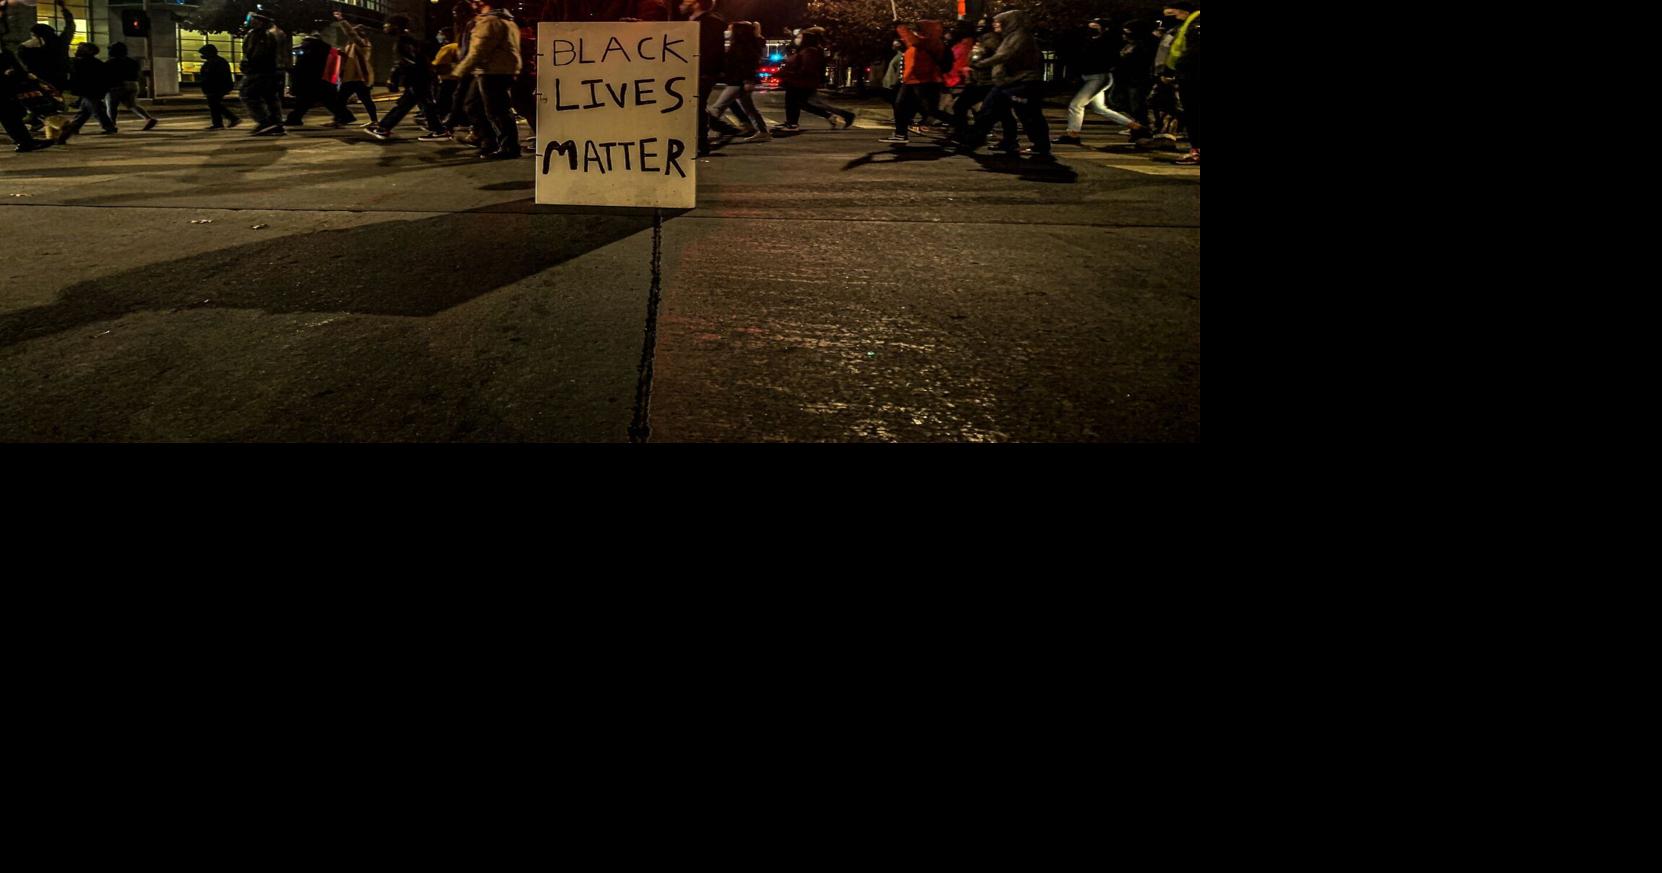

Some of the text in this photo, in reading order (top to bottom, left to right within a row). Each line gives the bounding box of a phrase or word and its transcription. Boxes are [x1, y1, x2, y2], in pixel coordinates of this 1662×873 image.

[552, 34, 689, 67] BLACK
[555, 76, 686, 113] LIVES
[542, 137, 686, 178] MATTER
